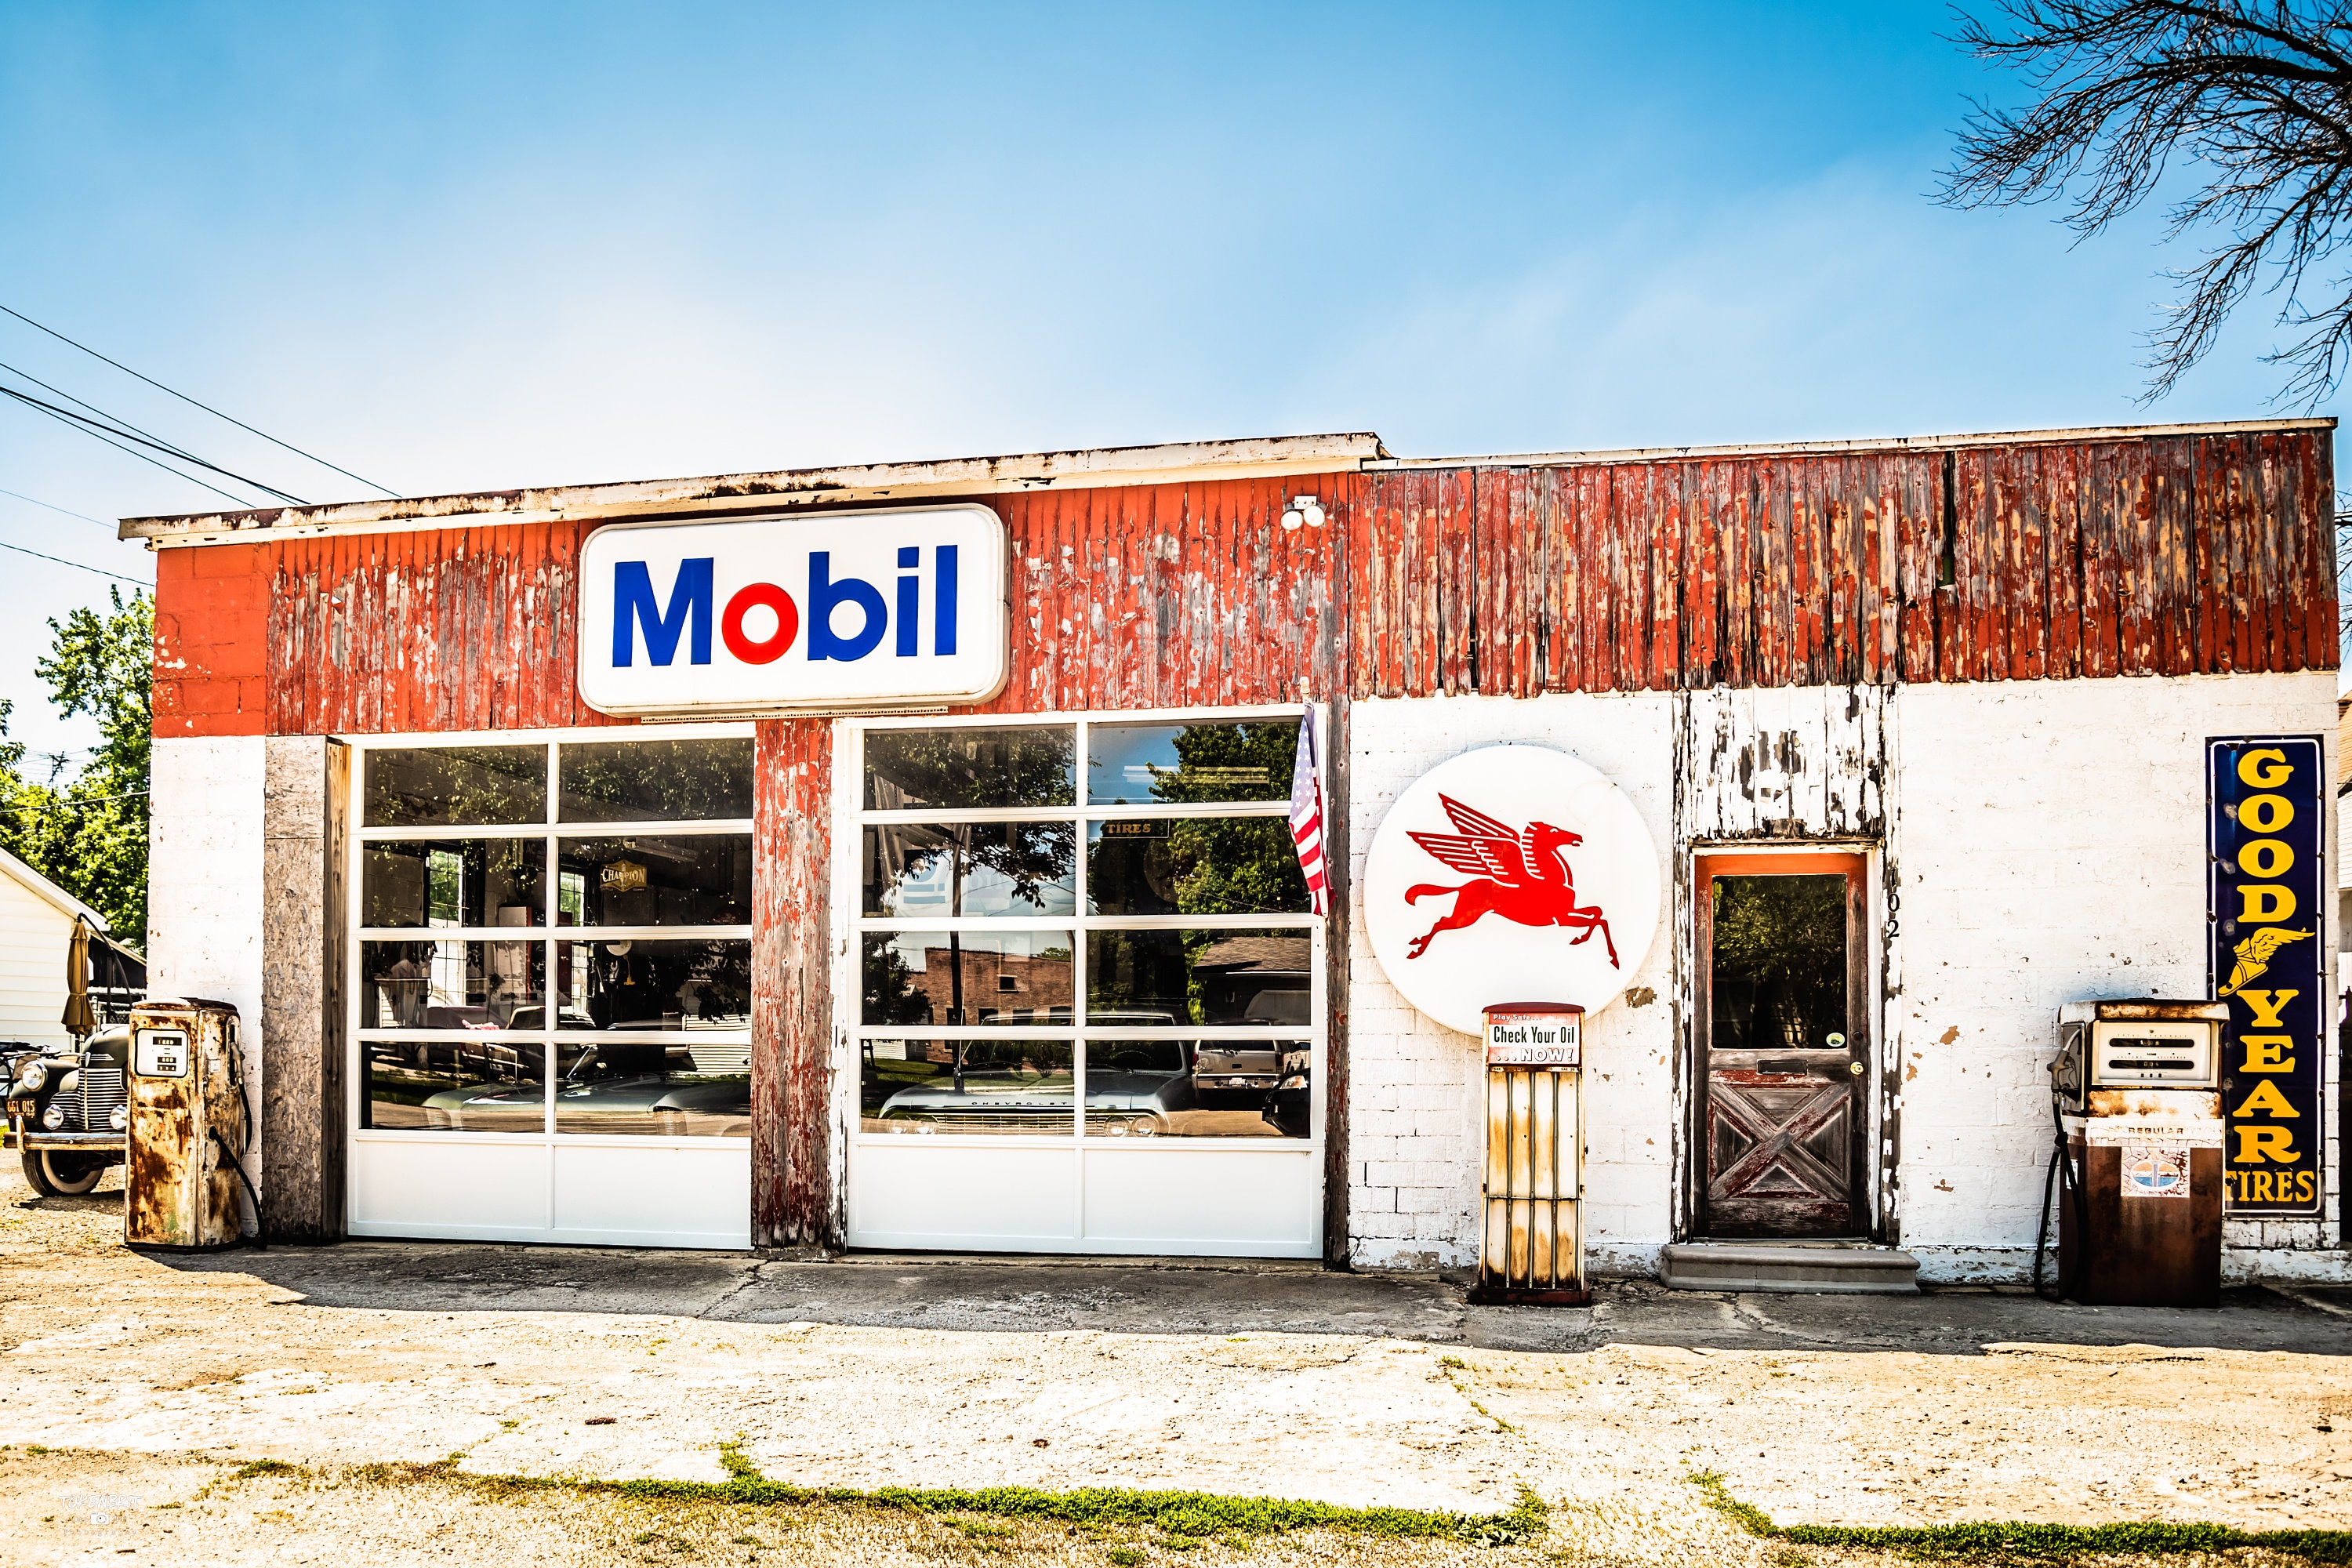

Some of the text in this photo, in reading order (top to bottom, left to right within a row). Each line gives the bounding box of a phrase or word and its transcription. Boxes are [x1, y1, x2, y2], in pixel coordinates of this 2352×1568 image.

[612, 545, 958, 667] Mobil
[1105, 823, 1152, 833] TIRES
[2232, 748, 2301, 1163] GOOD YEAR
[1494, 1026, 1574, 1043] Check Your Oil
